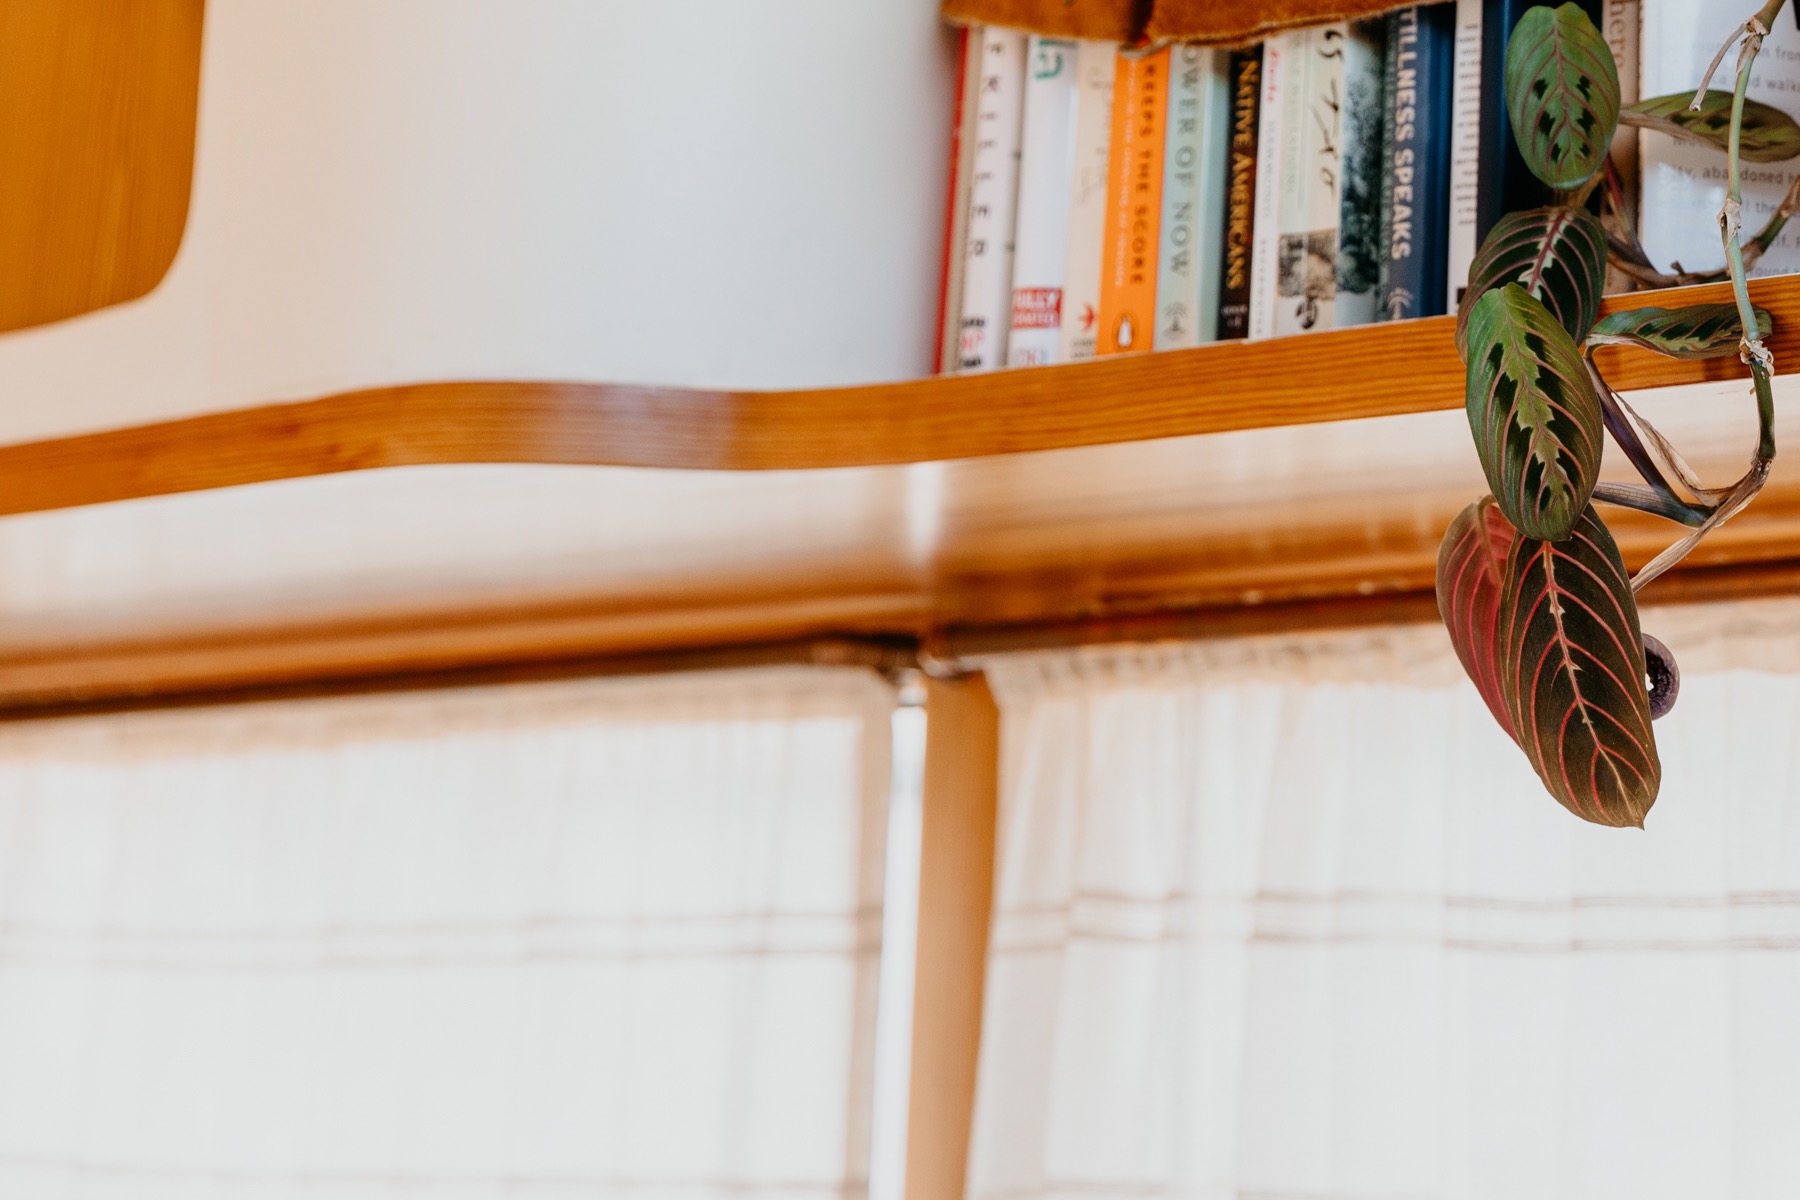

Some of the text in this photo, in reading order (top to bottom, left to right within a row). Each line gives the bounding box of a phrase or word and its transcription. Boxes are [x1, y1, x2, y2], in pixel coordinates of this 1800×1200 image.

[1130, 63, 1156, 286] KEEPS THE SCORE
[1169, 46, 1200, 277] OWER OF NOW
[1233, 59, 1260, 147] NATIVE
[1389, 6, 1418, 261] TILLNESS SPEAKS
[1701, 163, 1784, 186] abadoned
[1225, 152, 1255, 289] AMERICANS
